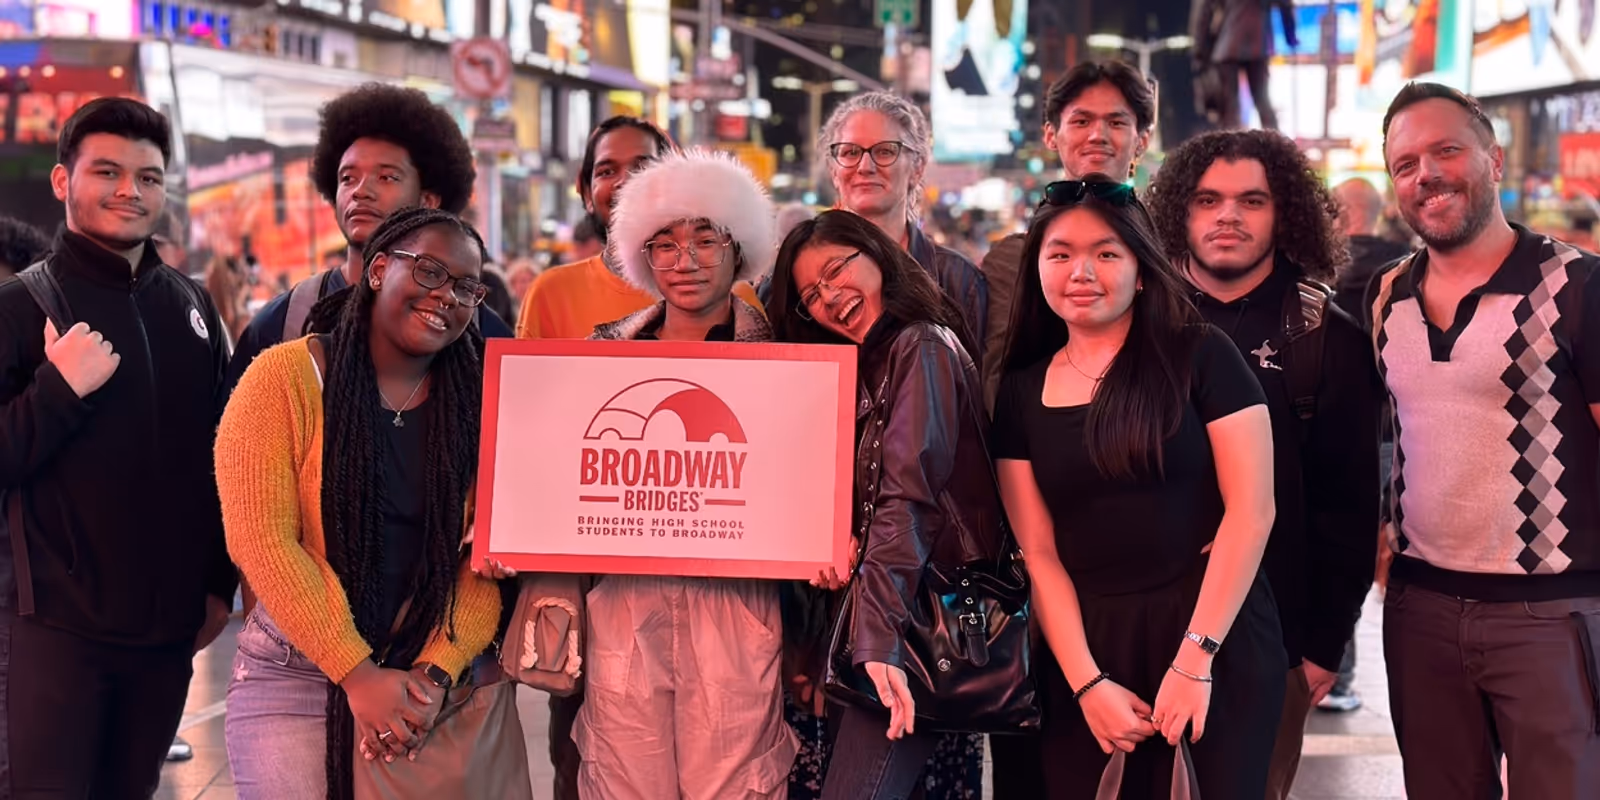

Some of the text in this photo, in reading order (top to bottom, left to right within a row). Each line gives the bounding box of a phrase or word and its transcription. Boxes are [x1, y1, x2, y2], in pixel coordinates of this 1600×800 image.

[580, 448, 747, 489] BROADWAY
[578, 516, 744, 528] BRINGING HIGH SCHOOL
[577, 527, 743, 539] STUDENTS TO BROADWAY
